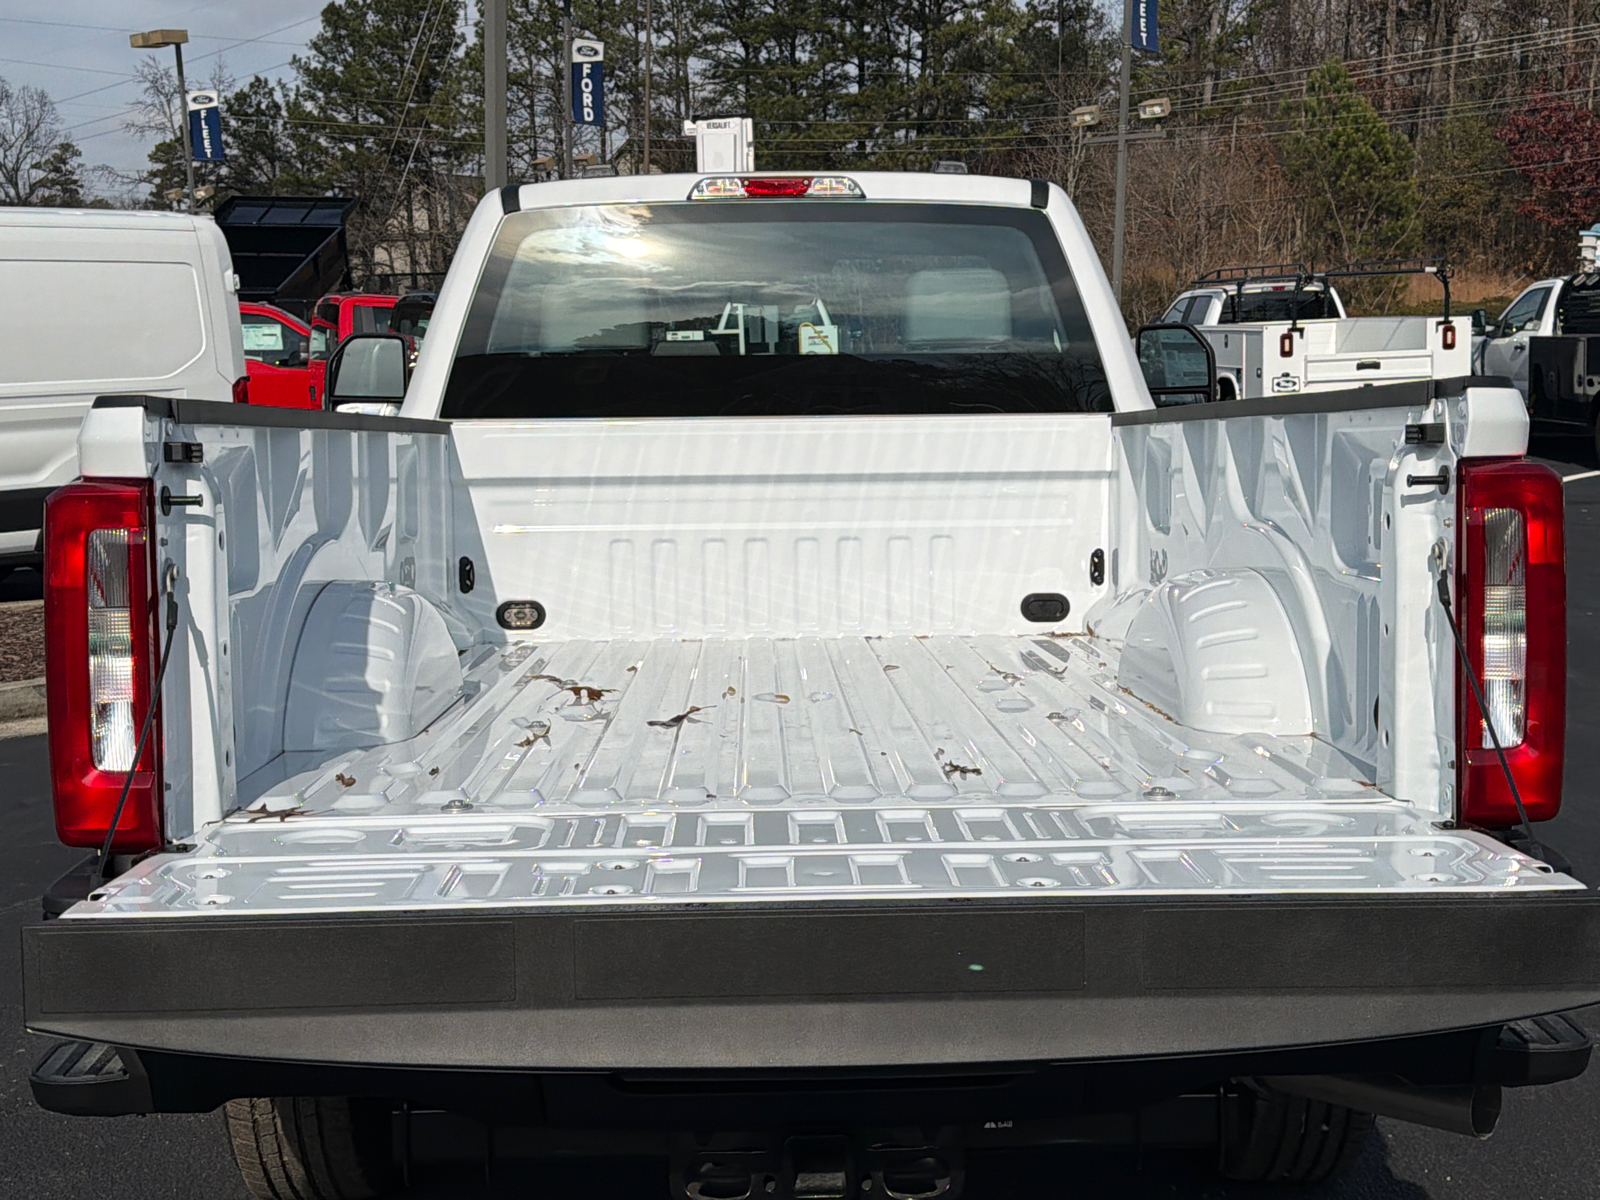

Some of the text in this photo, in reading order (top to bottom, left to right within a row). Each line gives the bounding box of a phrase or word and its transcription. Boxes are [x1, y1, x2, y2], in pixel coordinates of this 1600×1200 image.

[1139, 0, 1148, 46] EET
[580, 63, 595, 122] FORD
[200, 109, 213, 159] FLEET
